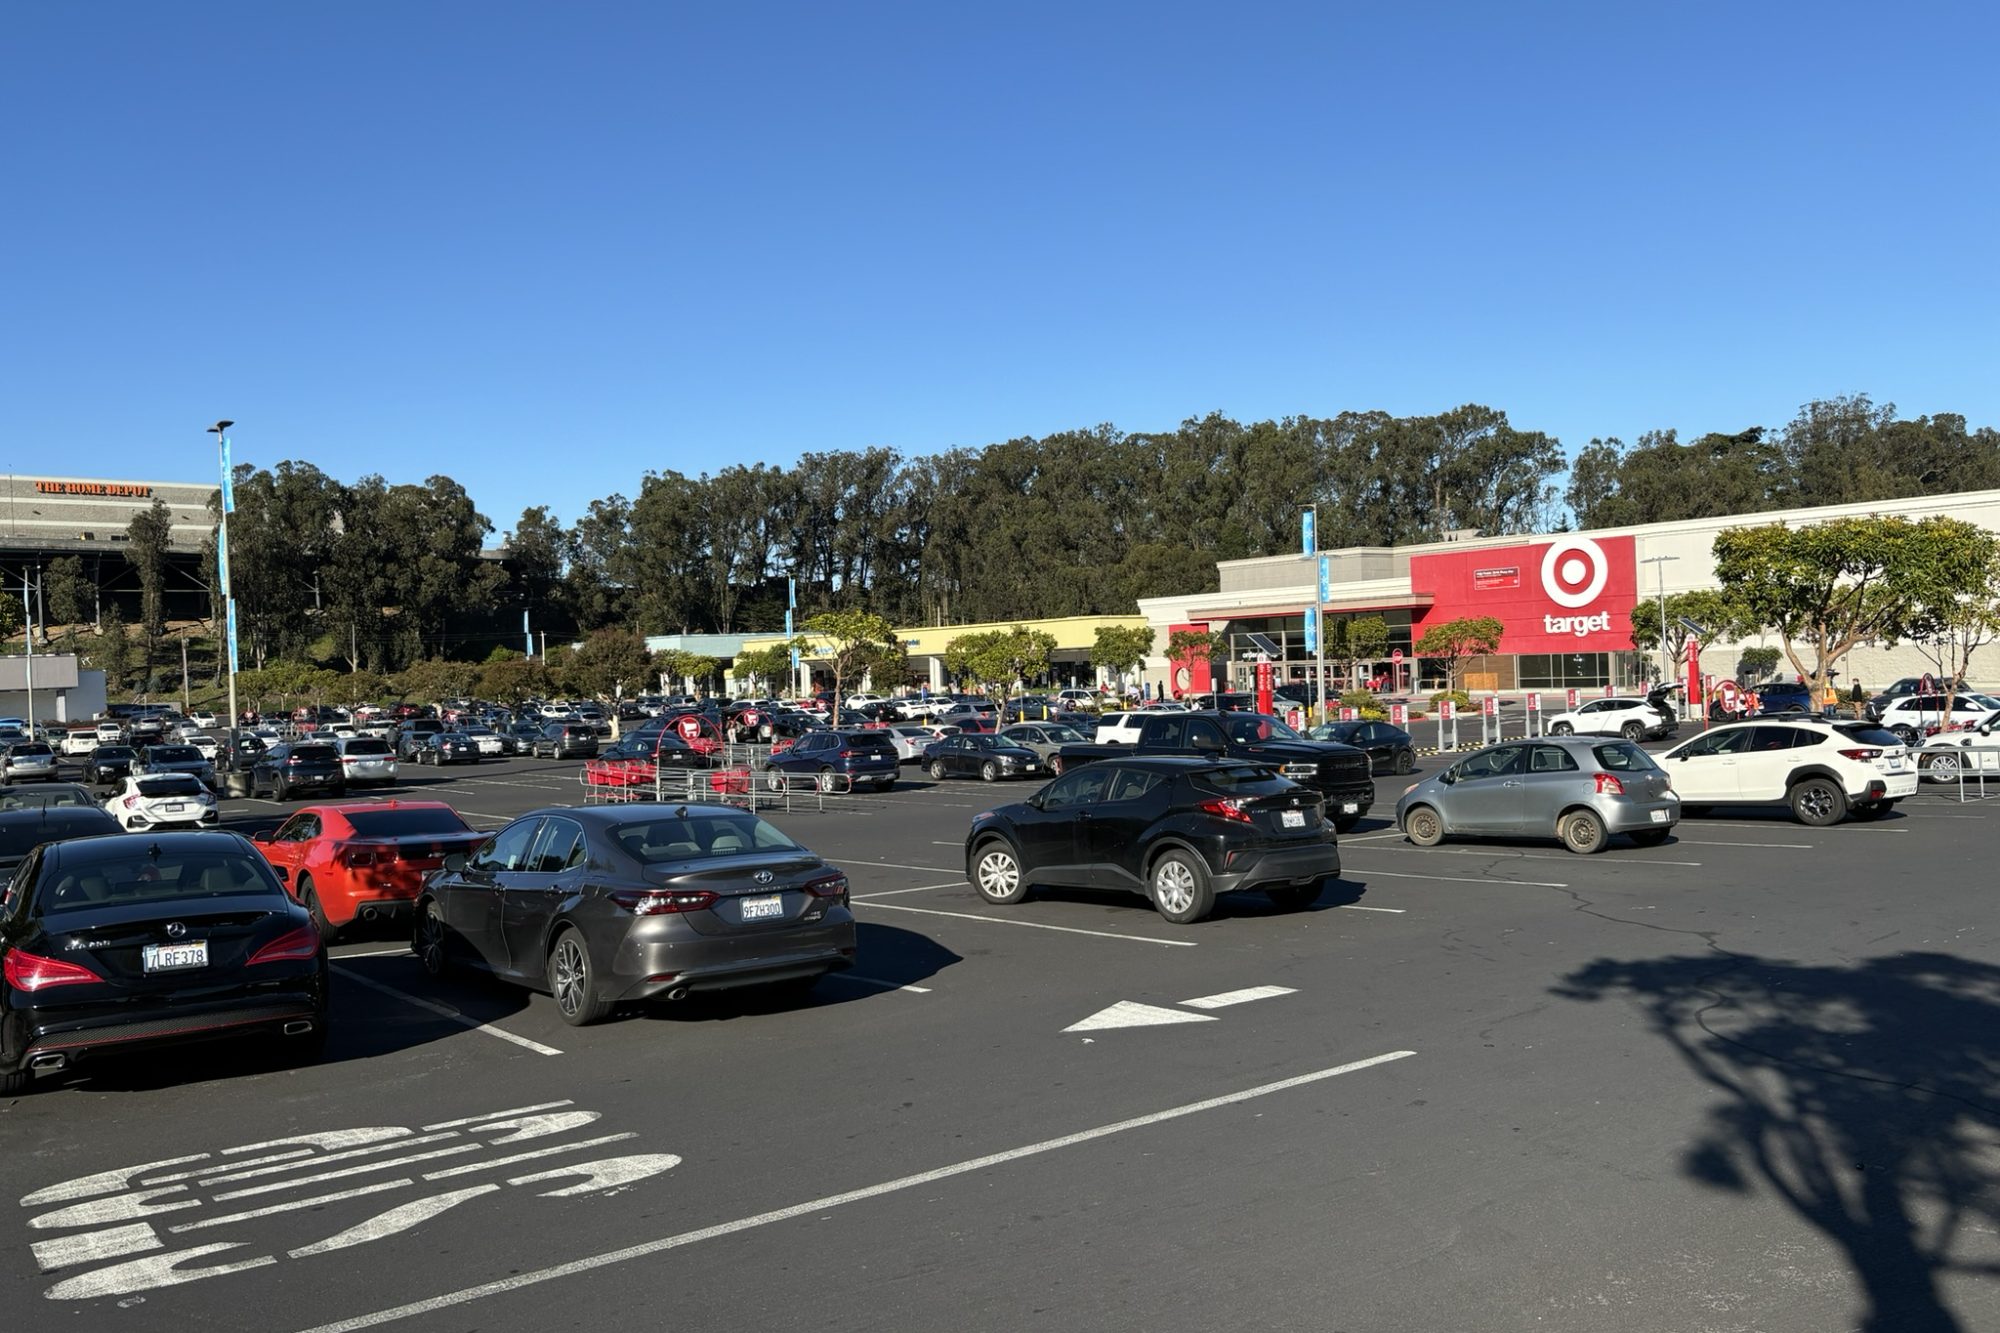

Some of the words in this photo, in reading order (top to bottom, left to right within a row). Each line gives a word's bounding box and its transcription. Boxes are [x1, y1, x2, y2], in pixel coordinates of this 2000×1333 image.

[35, 481, 62, 493] THE
[65, 481, 103, 496] HOME
[105, 484, 150, 497] DEPOT
[1543, 610, 1611, 637] target
[148, 949, 204, 967] 7LRF378
[19, 1098, 683, 1301] STOP
